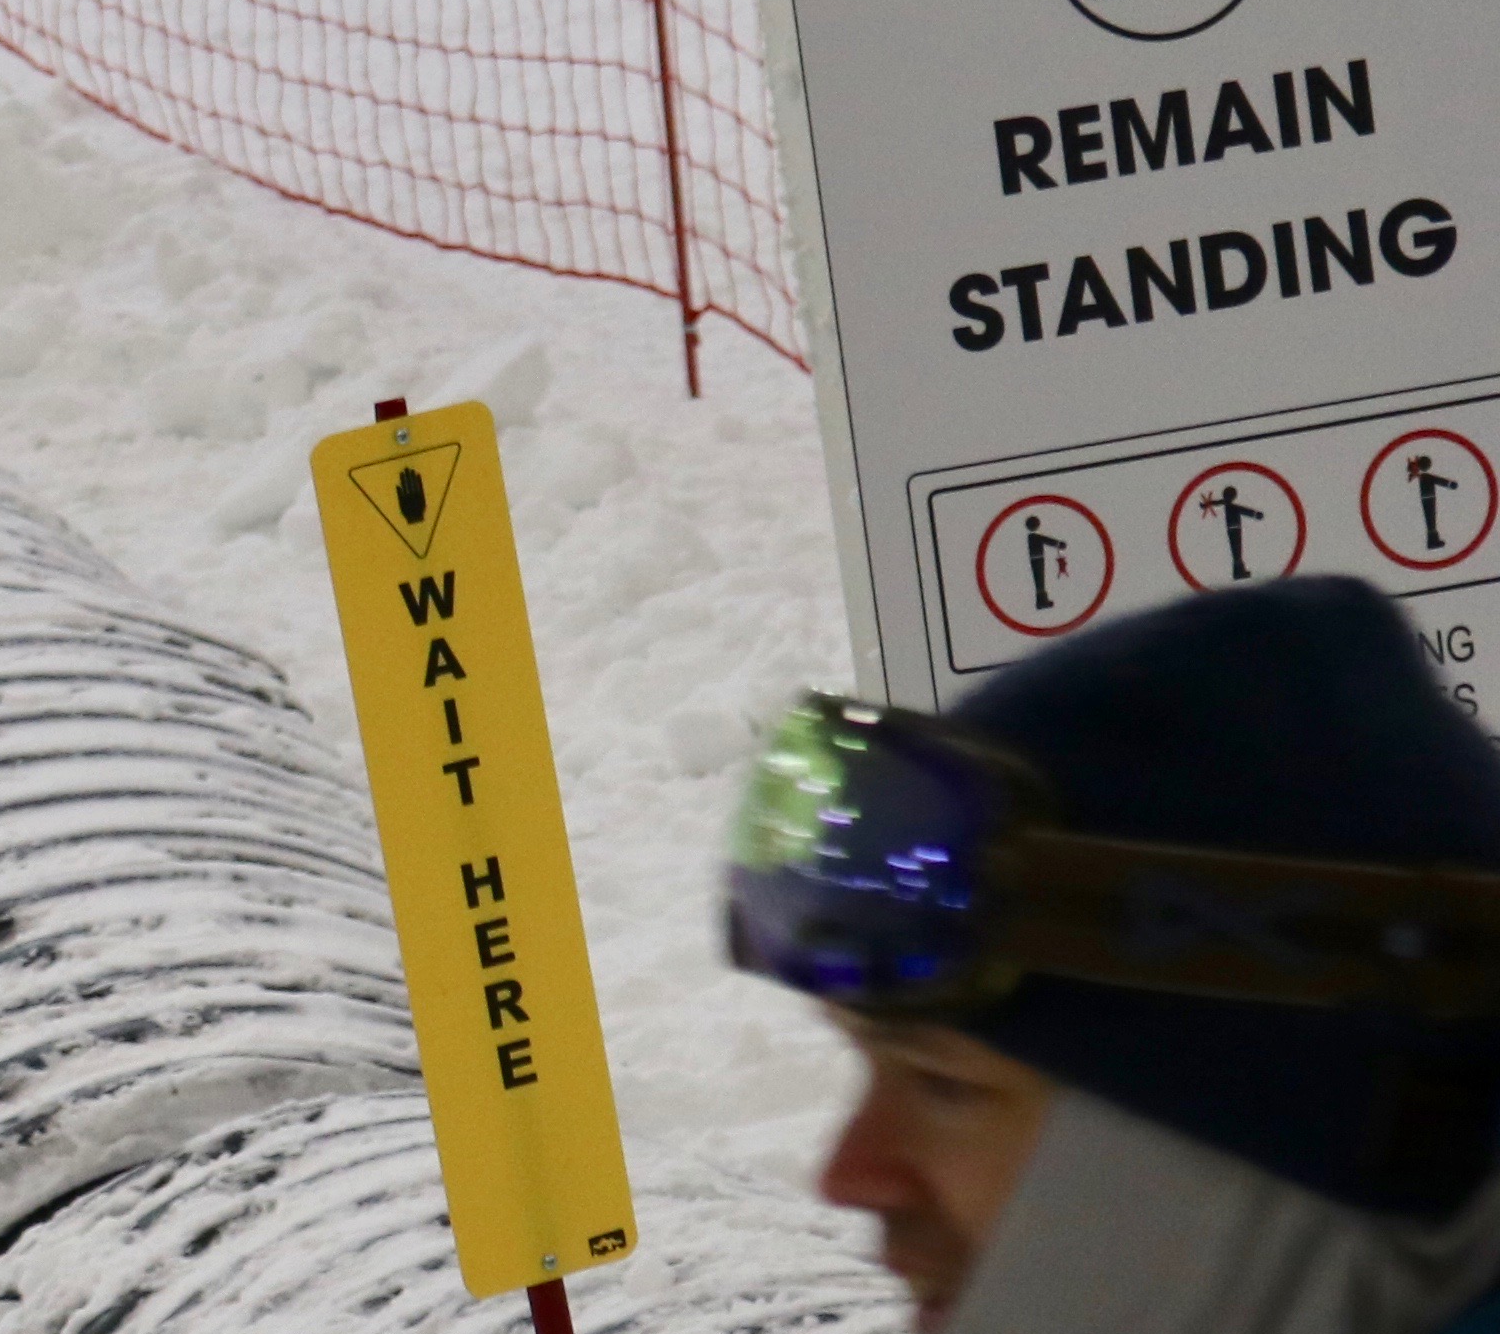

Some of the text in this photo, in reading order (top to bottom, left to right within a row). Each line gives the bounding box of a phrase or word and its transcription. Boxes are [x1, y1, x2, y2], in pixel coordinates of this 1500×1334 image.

[992, 57, 1376, 197] REMAIN
[948, 196, 1458, 353] STANDING
[397, 569, 539, 1091] WAIT HERE
